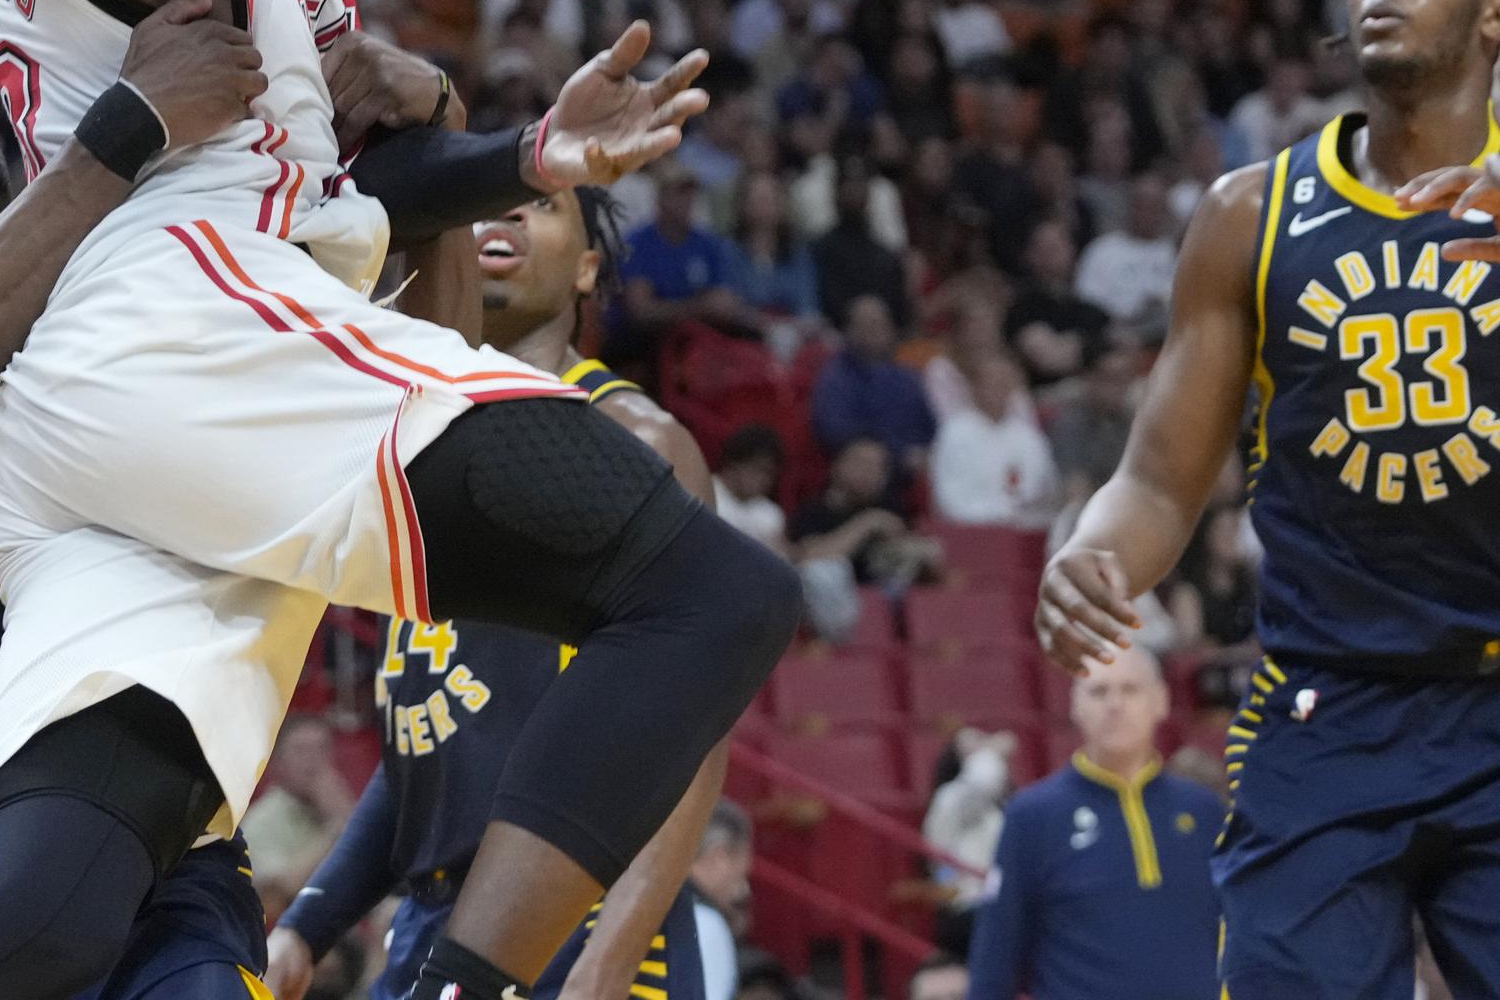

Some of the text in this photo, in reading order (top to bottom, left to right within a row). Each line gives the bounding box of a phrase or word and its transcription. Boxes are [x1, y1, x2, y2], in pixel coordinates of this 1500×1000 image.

[1293, 176, 1316, 204] 6
[1287, 239, 1500, 350] INDIANA
[1337, 312, 1473, 433] 33
[1308, 405, 1500, 503] PACERS
